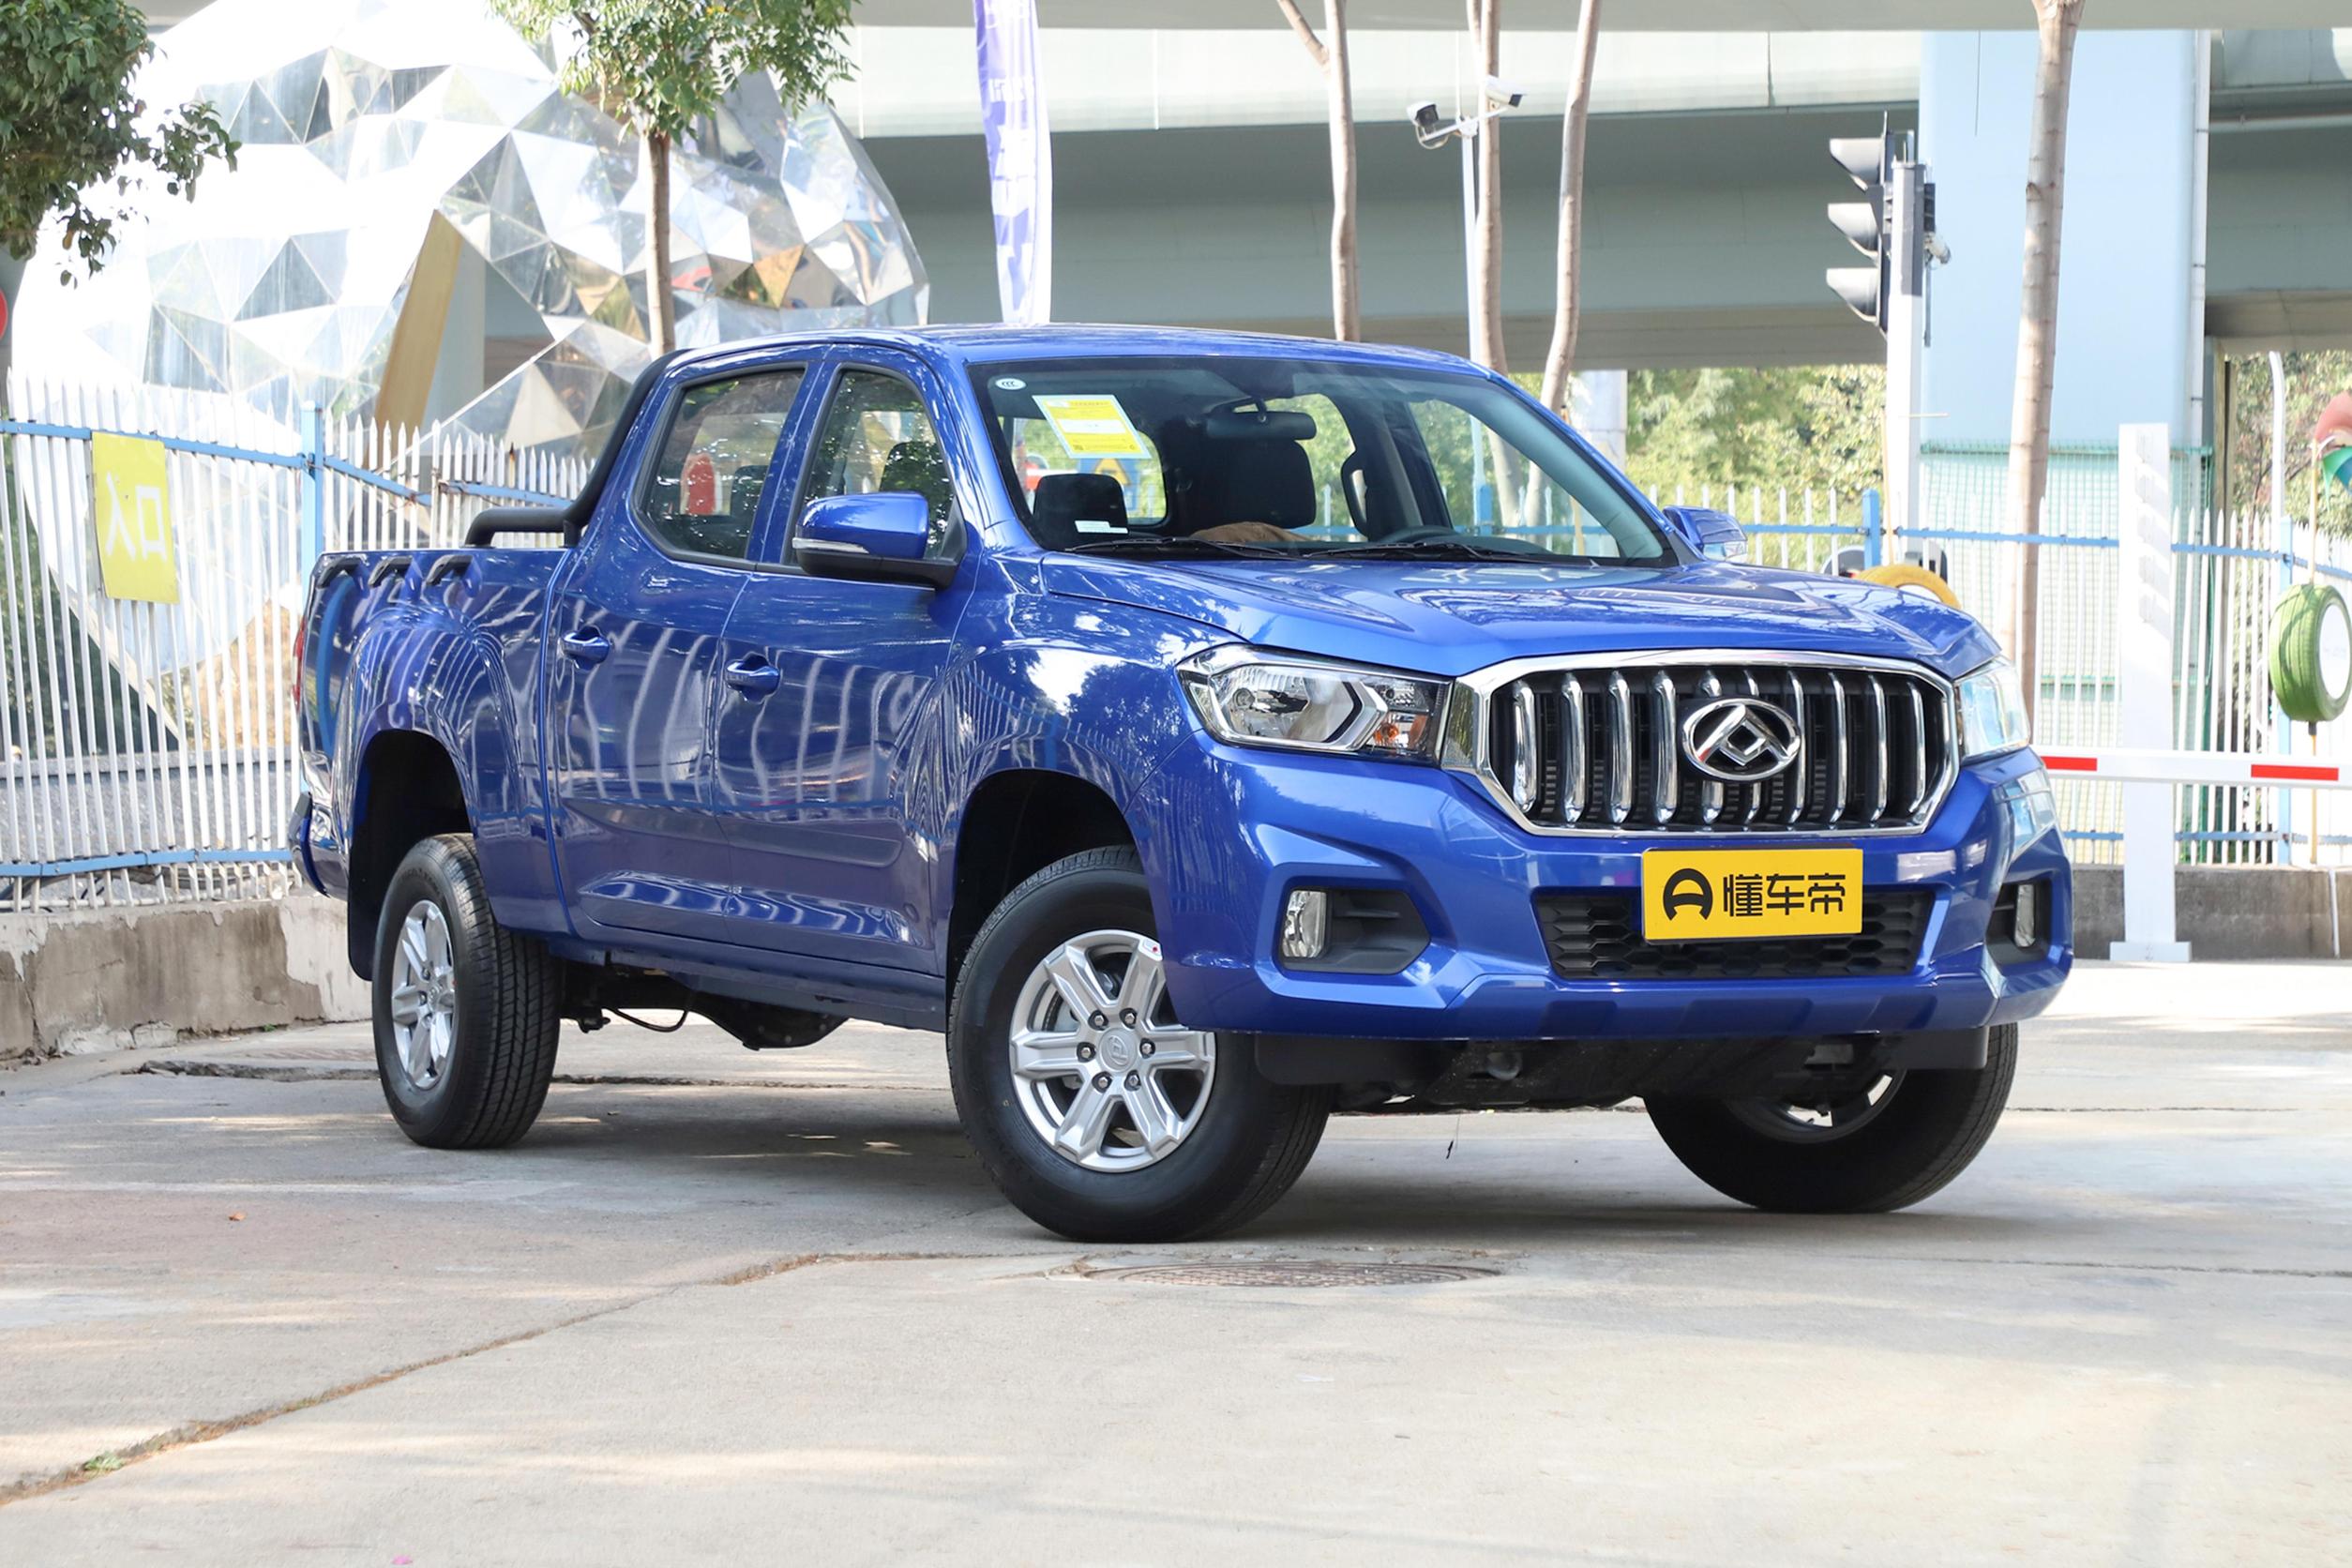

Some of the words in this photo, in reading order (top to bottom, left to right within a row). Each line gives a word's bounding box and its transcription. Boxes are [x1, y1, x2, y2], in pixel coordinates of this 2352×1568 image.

[105, 471, 167, 561] 入口
[1723, 872, 1846, 917] 懂车帝
